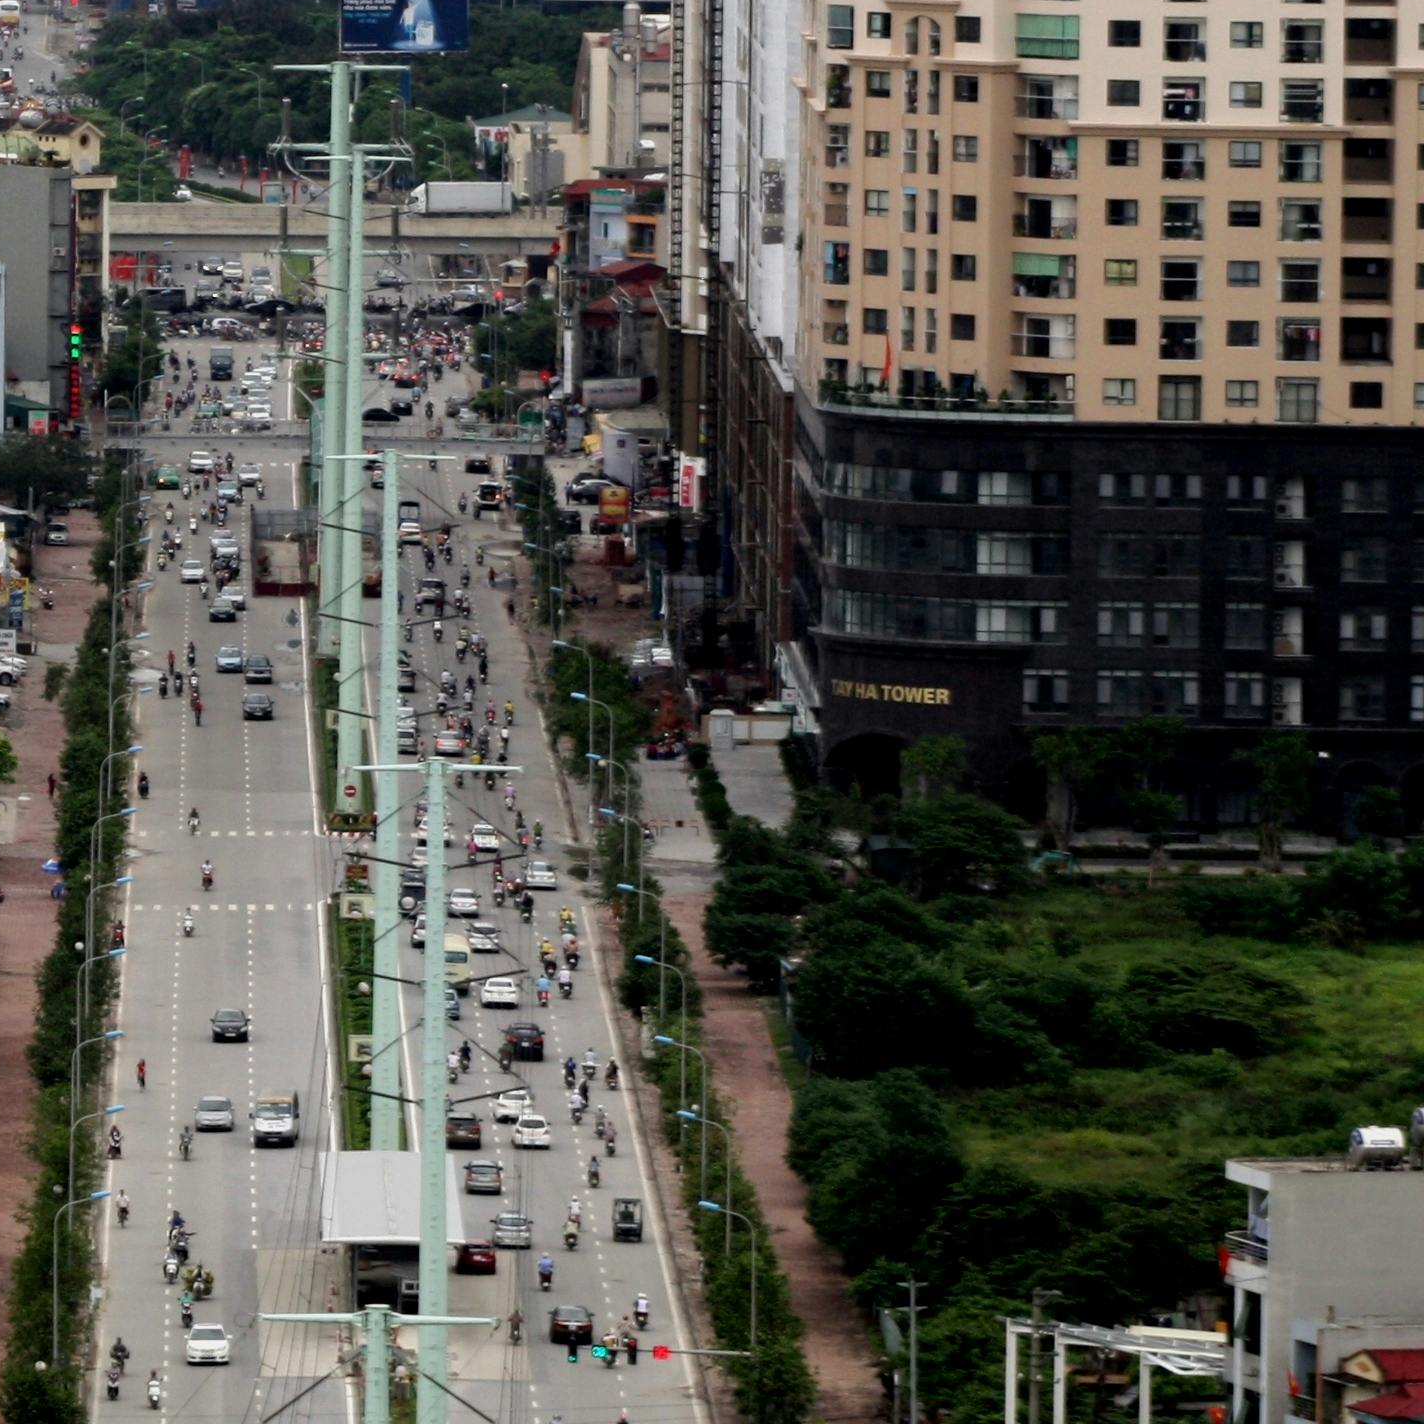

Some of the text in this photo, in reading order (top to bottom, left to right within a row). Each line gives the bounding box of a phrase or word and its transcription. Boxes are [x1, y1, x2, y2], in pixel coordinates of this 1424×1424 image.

[832, 679, 950, 705] TAY HA TOWER
